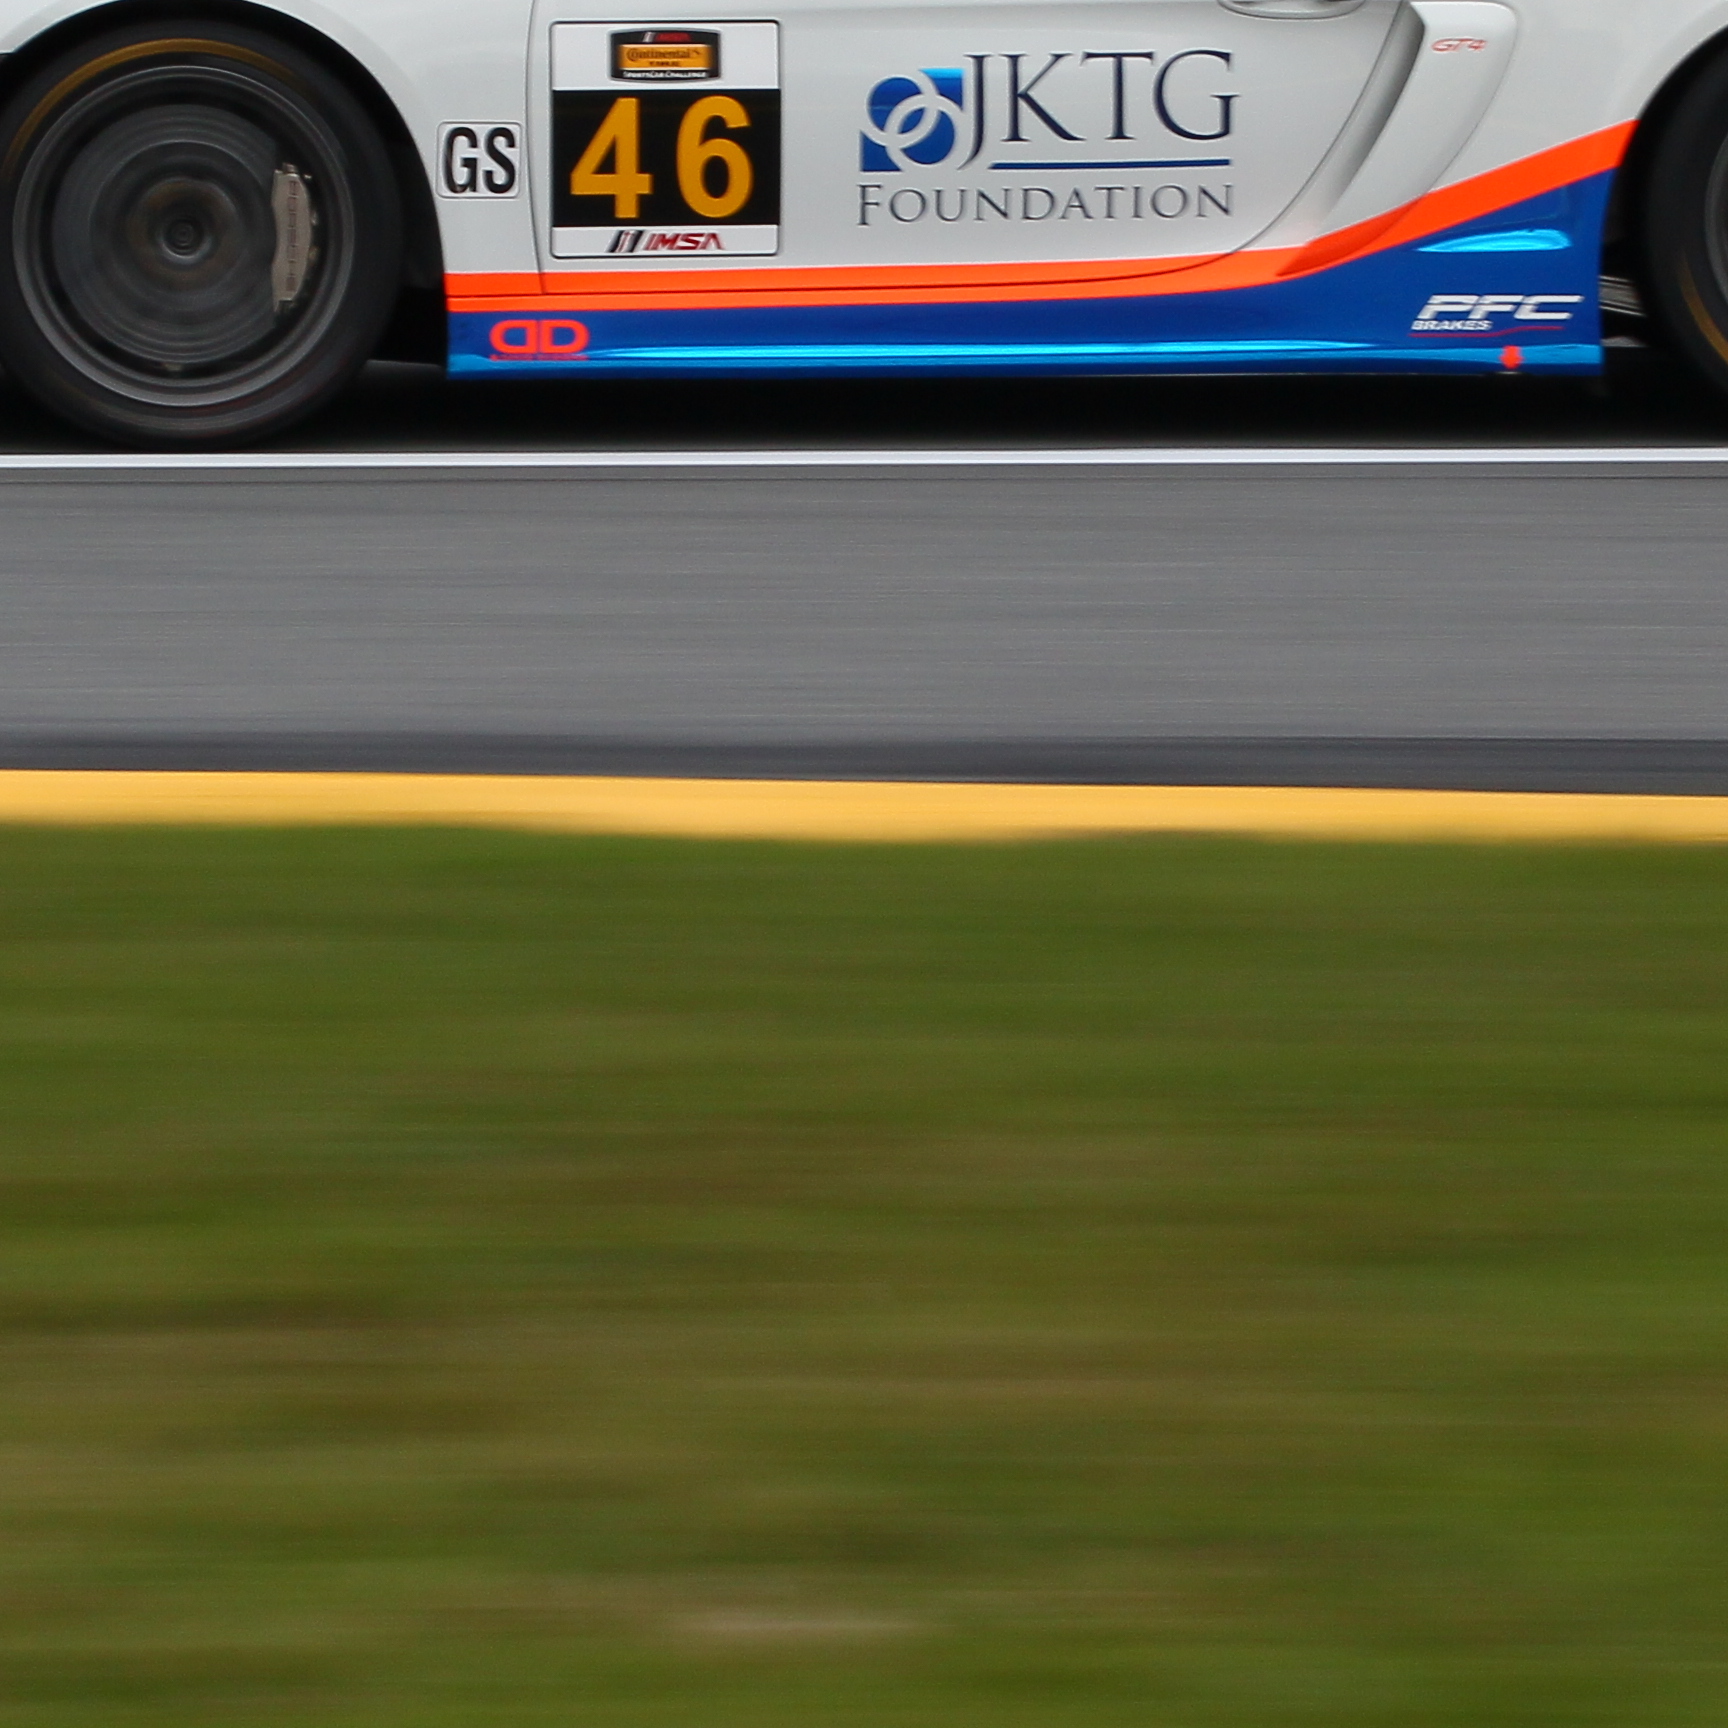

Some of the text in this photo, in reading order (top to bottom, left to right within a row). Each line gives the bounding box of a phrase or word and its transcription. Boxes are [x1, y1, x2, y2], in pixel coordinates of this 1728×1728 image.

[1431, 38, 1488, 52] GT4
[957, 49, 1241, 171] JKTG
[443, 126, 516, 194] GS
[570, 95, 754, 218] 46
[856, 183, 1235, 227] FOUNDATION
[643, 231, 726, 251] IMSA
[1416, 294, 1586, 320] PFC
[1410, 319, 1494, 331] BRAKES
